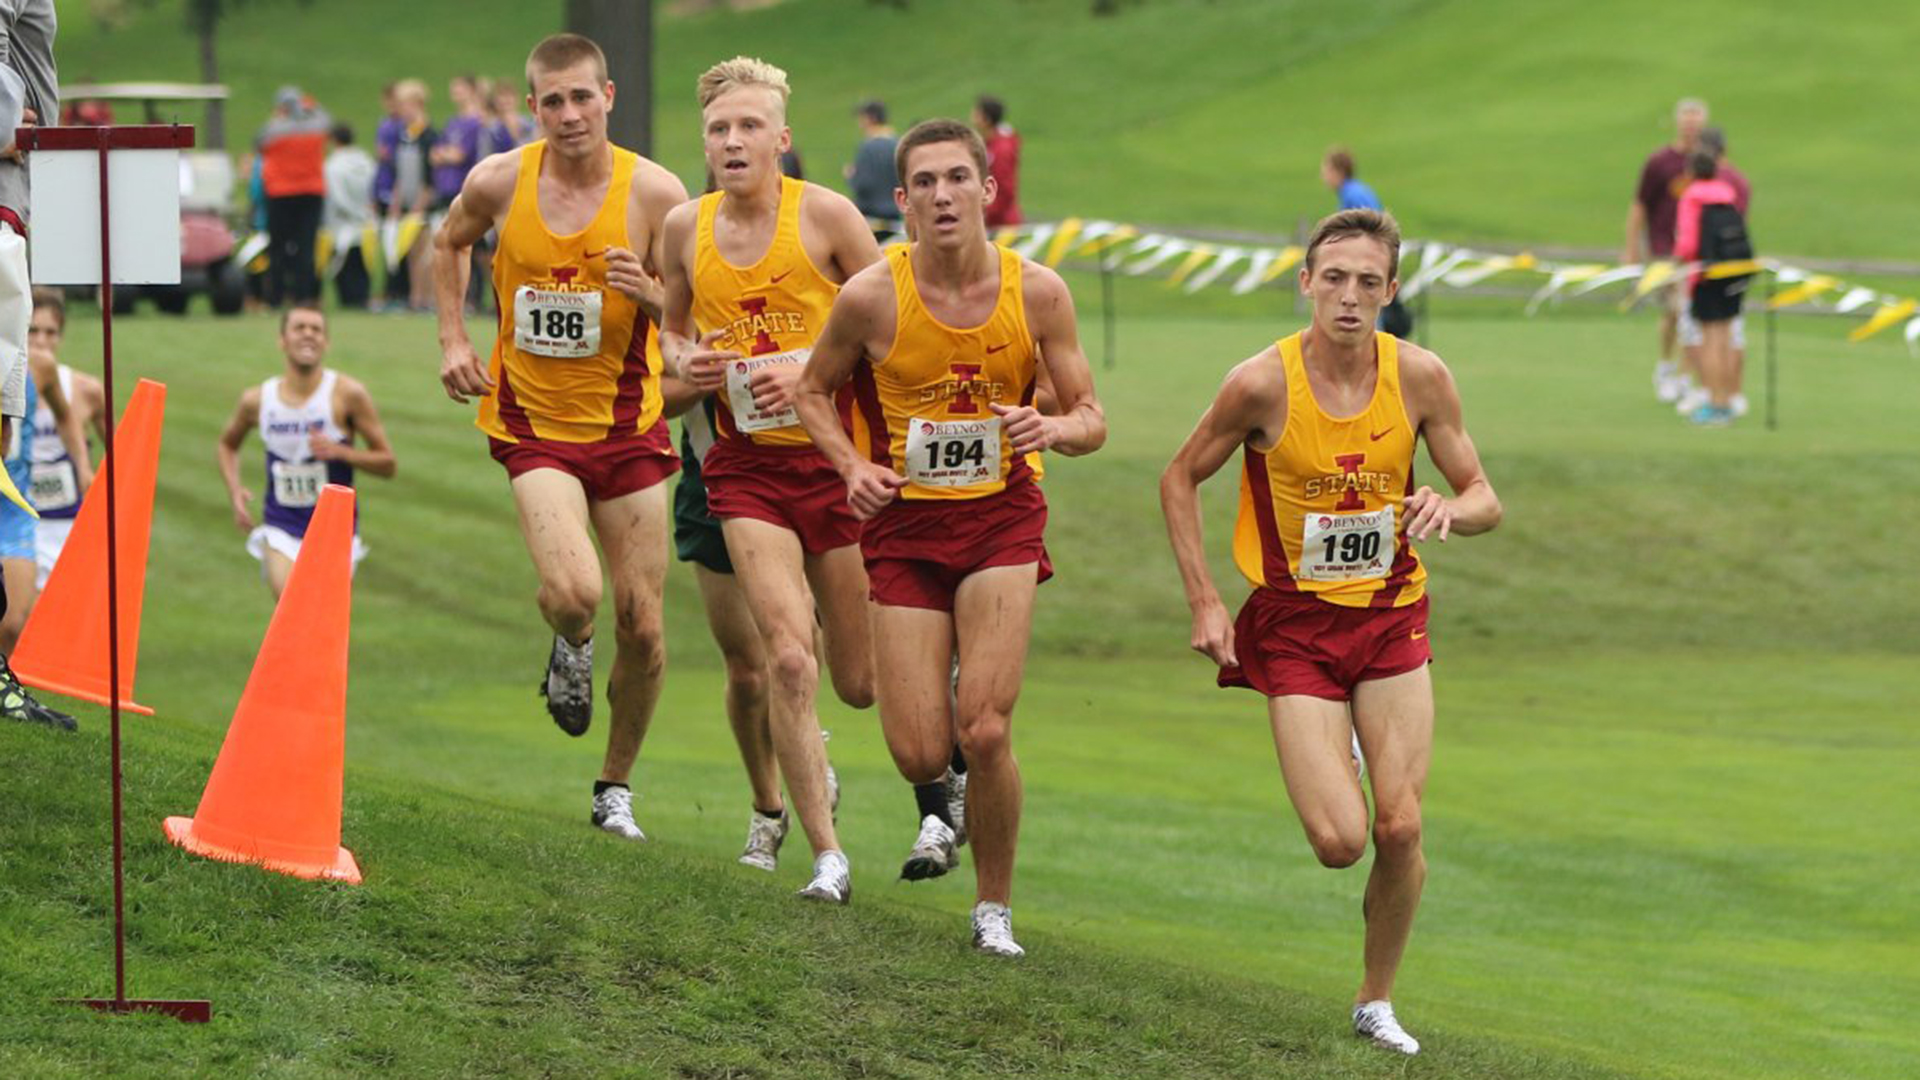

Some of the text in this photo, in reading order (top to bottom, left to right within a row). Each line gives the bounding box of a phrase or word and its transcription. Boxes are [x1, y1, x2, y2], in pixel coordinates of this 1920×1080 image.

[528, 309, 584, 340] 186
[722, 312, 806, 349] STATE
[919, 381, 1004, 402] STATE
[936, 422, 988, 435] BEYNON
[925, 439, 985, 470] 194
[1304, 472, 1391, 499] STATE
[1322, 530, 1381, 563] 190
